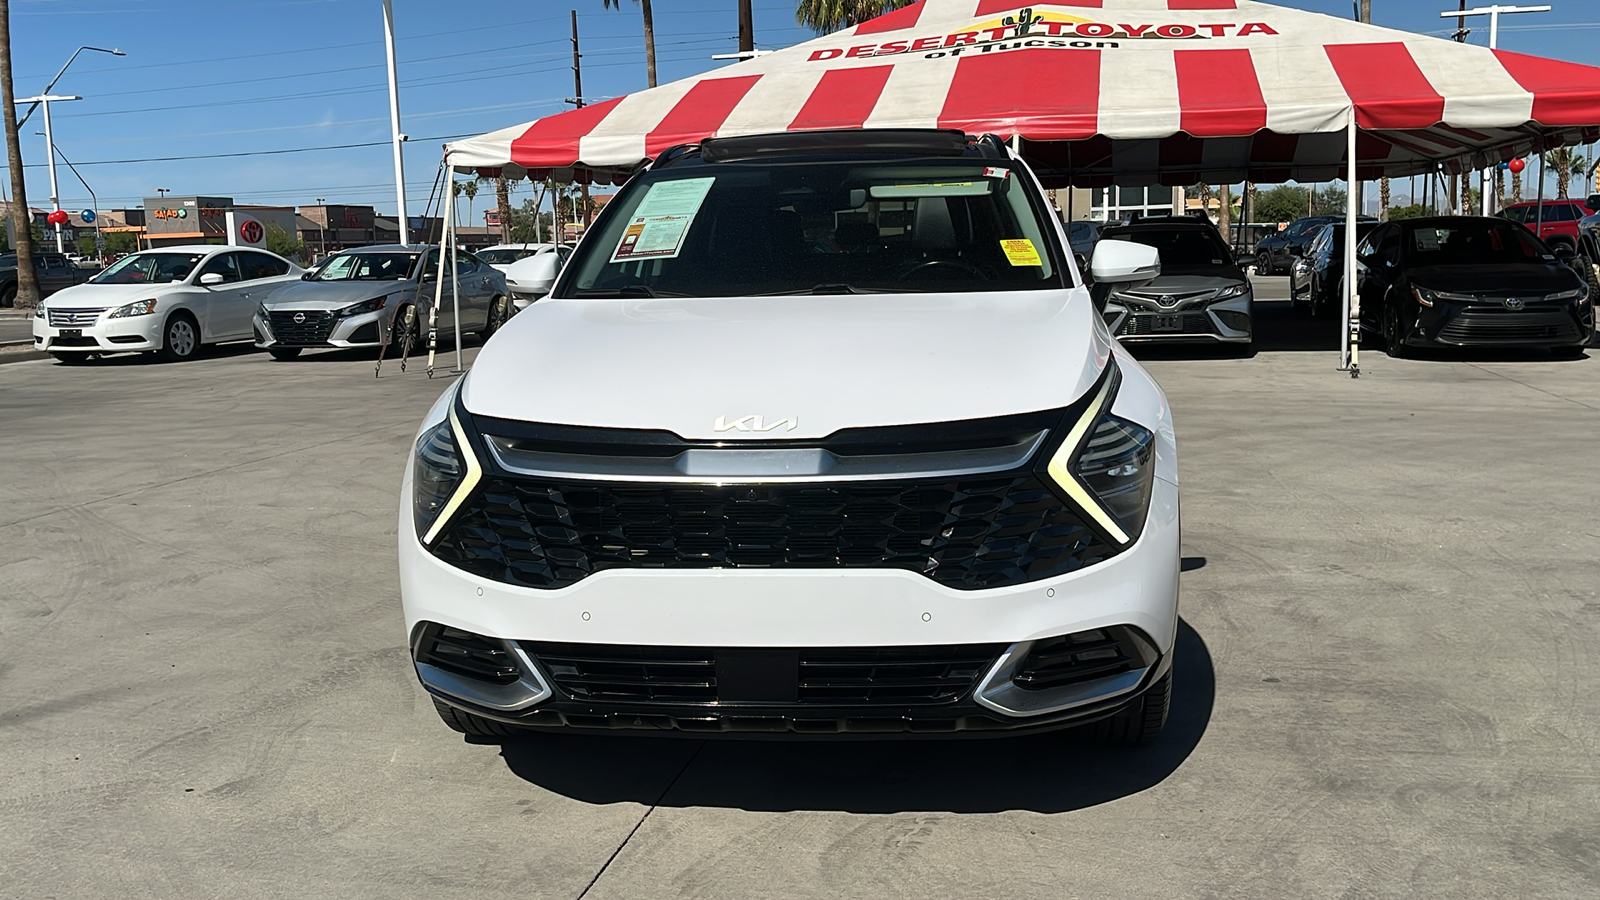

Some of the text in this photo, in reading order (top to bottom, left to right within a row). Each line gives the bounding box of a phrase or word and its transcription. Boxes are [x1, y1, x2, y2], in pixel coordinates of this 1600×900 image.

[806, 21, 1280, 62] DESERT TOYOTA
[924, 39, 1120, 59] of Tucson
